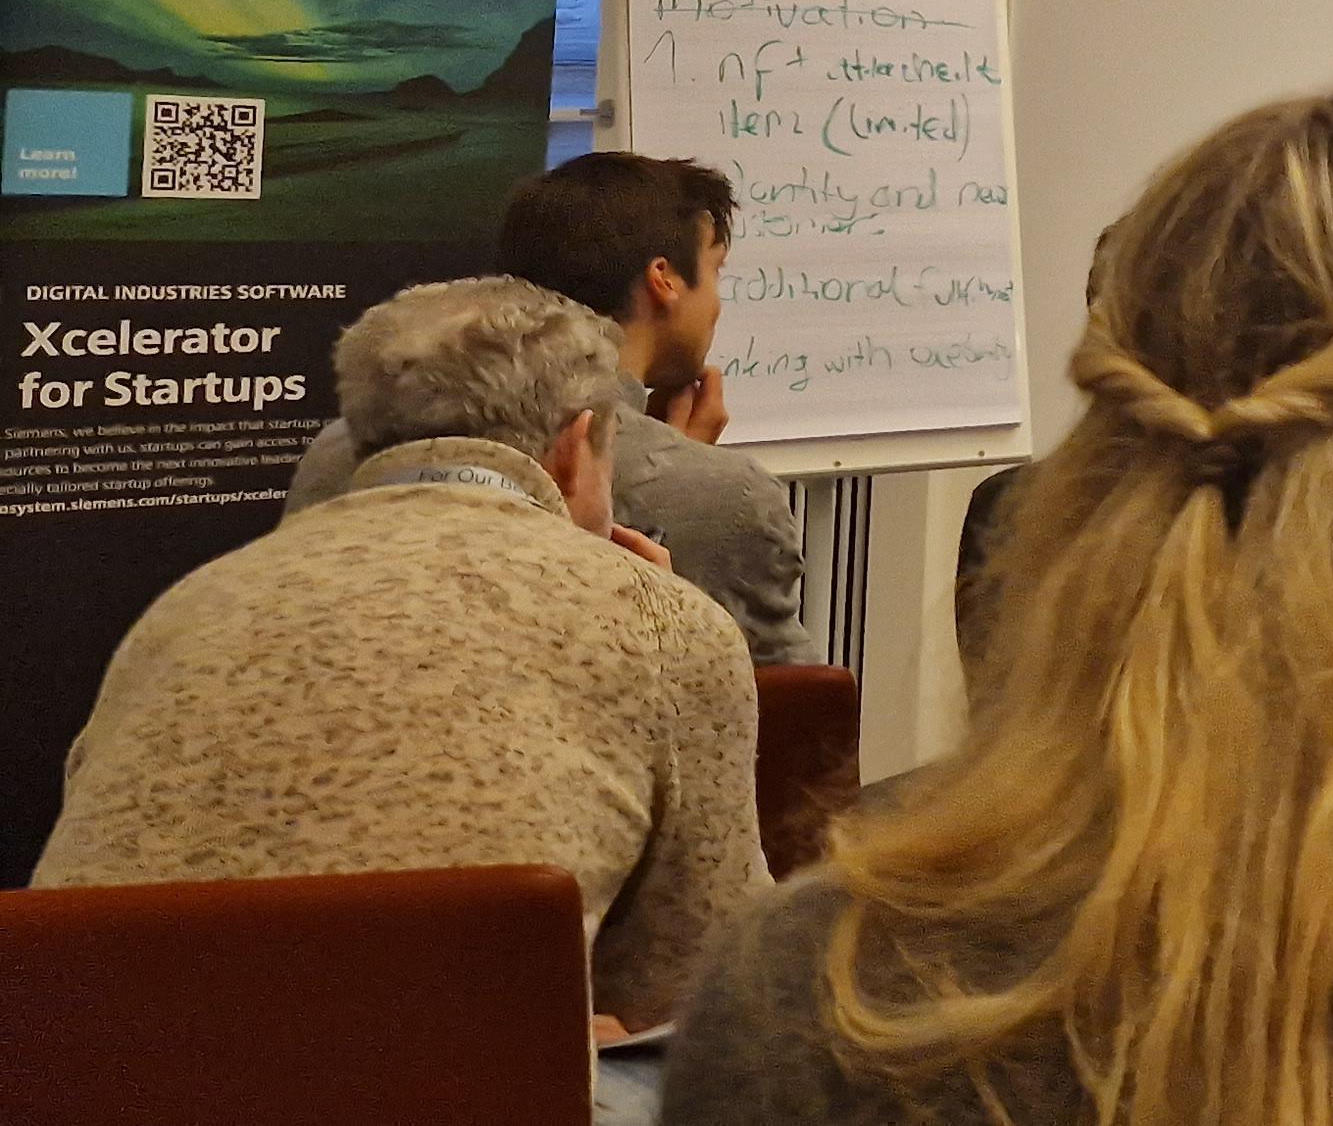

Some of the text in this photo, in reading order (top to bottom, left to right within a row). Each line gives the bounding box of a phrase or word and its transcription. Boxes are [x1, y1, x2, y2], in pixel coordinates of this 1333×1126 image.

[27, 284, 346, 301] DIGITAL INDUSTRIES SOFTWARE
[20, 320, 281, 357] Xcelerator
[18, 371, 306, 410] for Startups
[84, 443, 114, 455] with
[198, 440, 221, 450] can
[257, 437, 298, 448] access
